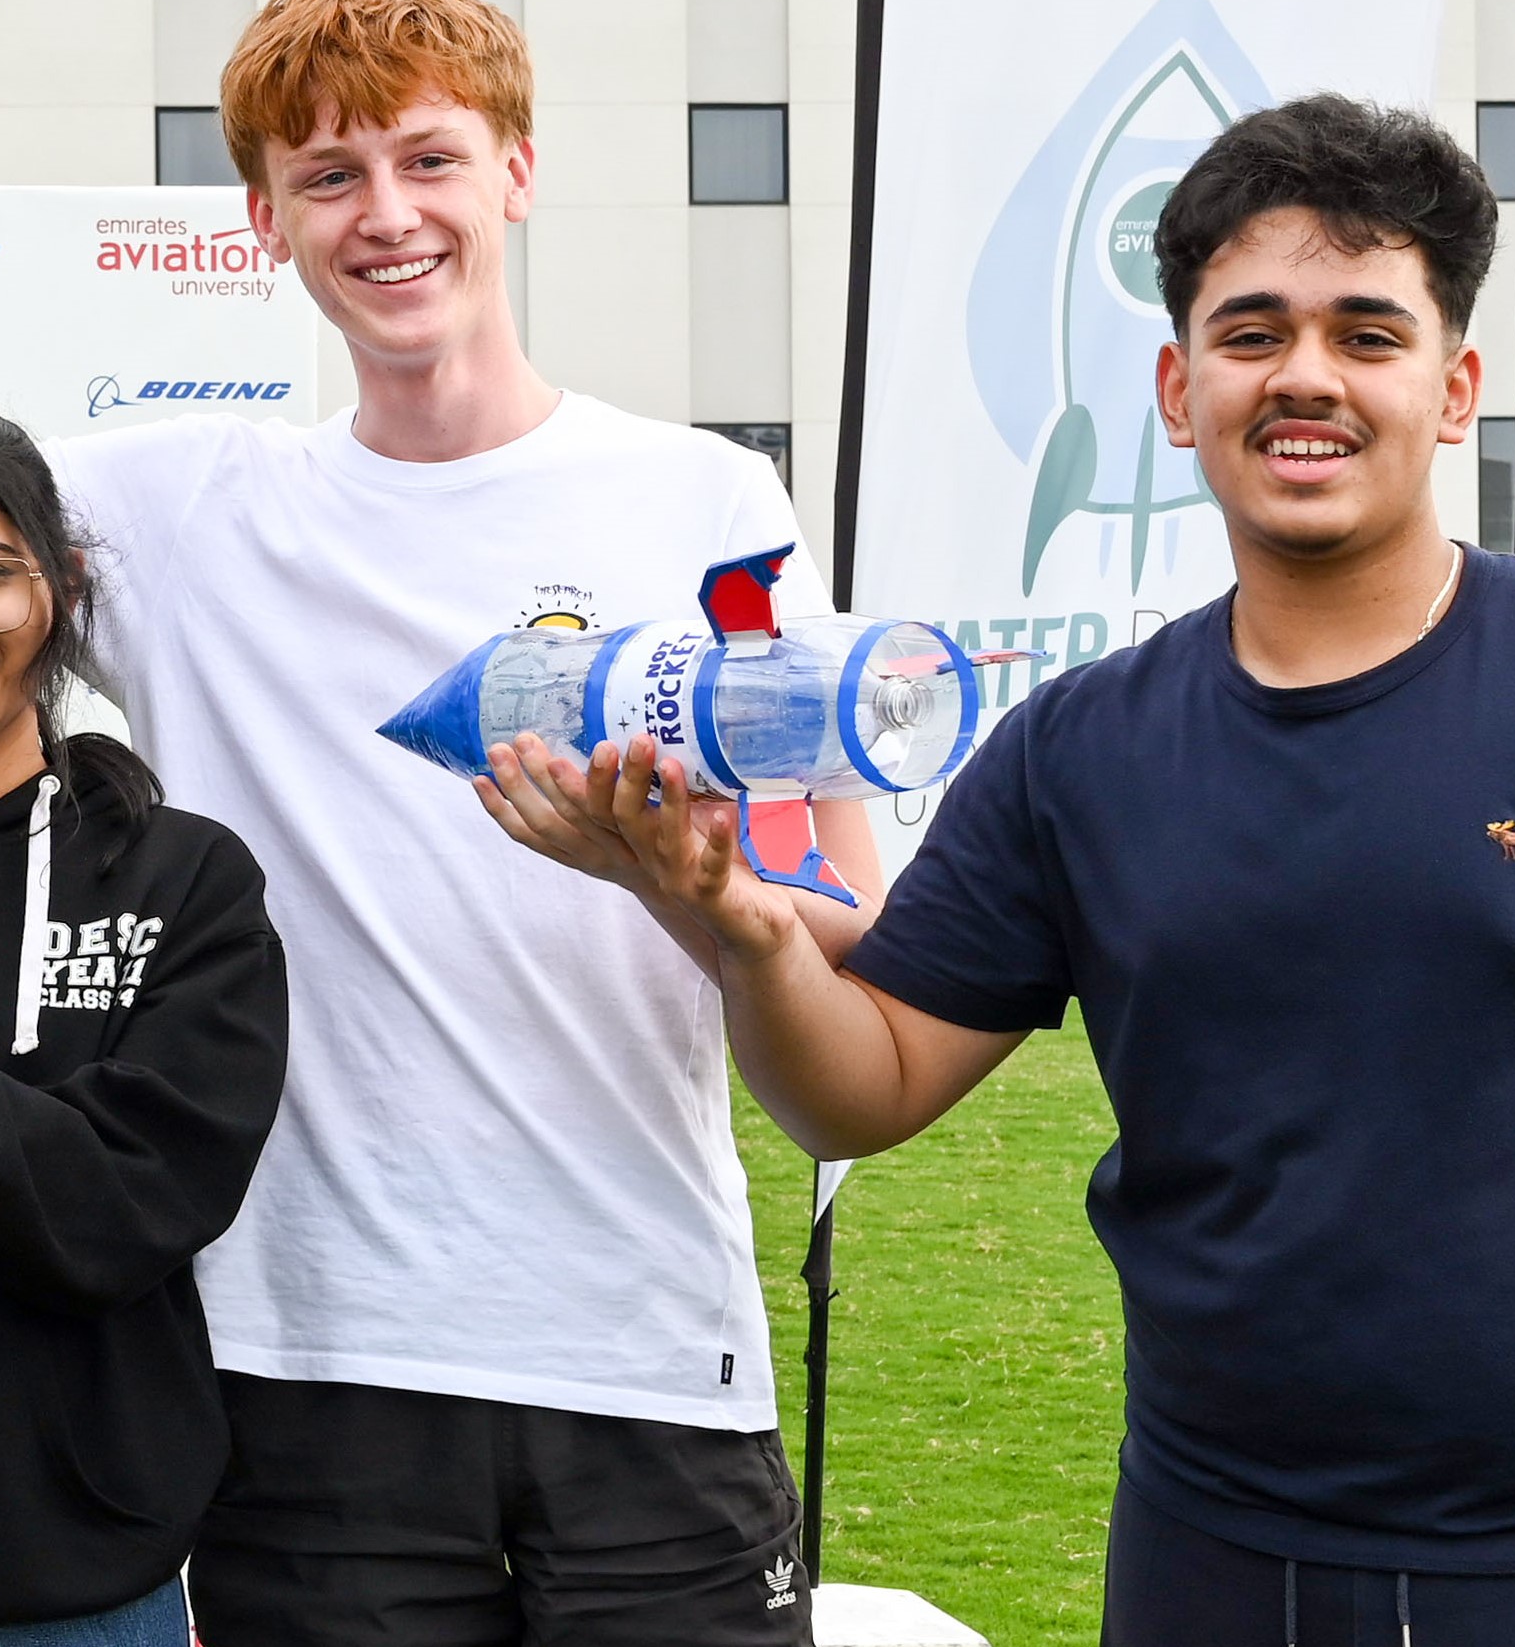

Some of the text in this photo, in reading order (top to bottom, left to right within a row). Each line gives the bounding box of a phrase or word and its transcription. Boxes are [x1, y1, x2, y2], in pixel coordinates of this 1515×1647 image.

[95, 217, 188, 236] emirates
[171, 277, 276, 303] university
[135, 381, 292, 401] BOEING
[934, 611, 1109, 710] ATER
[644, 640, 673, 738] IT'S NOT
[656, 632, 703, 746] ROCKET
[45, 912, 164, 959] DESC
[42, 956, 123, 988] YEA
[766, 1591, 797, 1610] adidas
